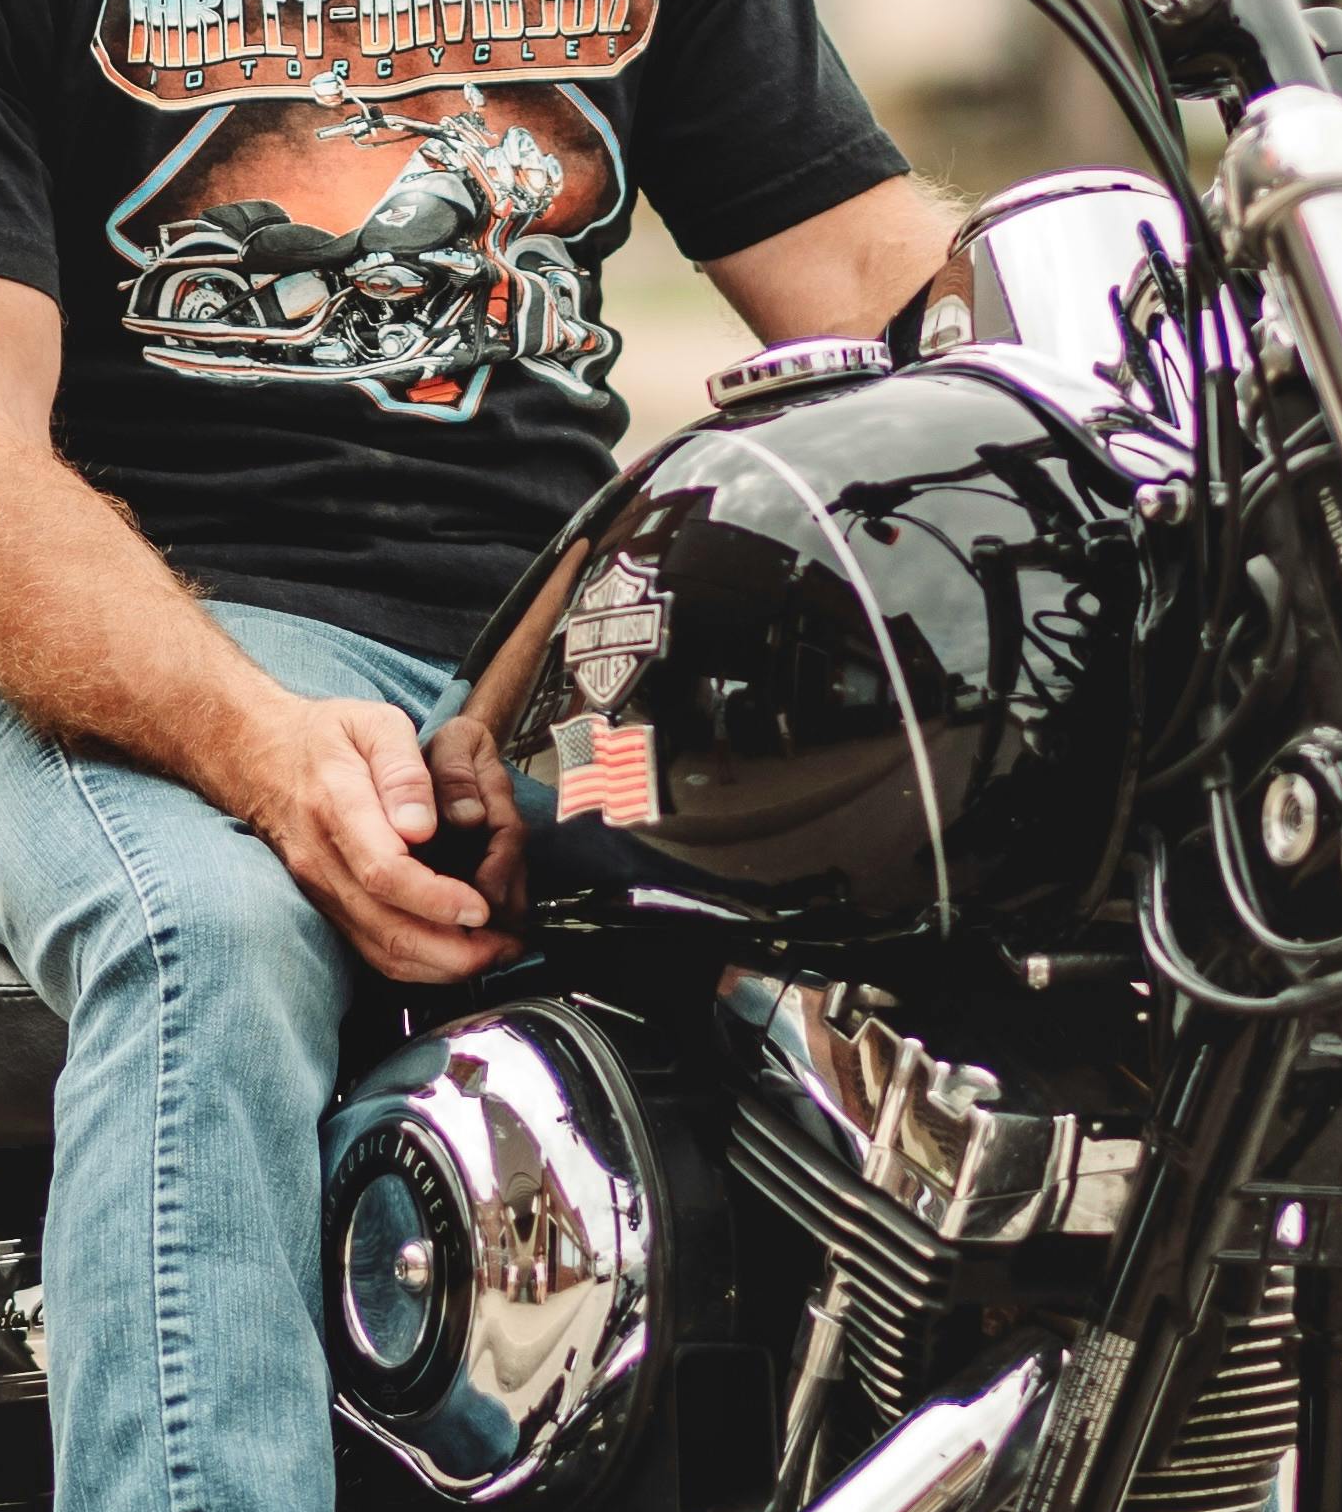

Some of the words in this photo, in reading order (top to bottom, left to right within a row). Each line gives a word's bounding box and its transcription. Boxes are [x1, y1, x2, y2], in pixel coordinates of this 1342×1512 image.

[150, 37, 616, 89] OTORCYCLES
[339, 1134, 386, 1184] CUBIC
[394, 1133, 448, 1233] INCHES
